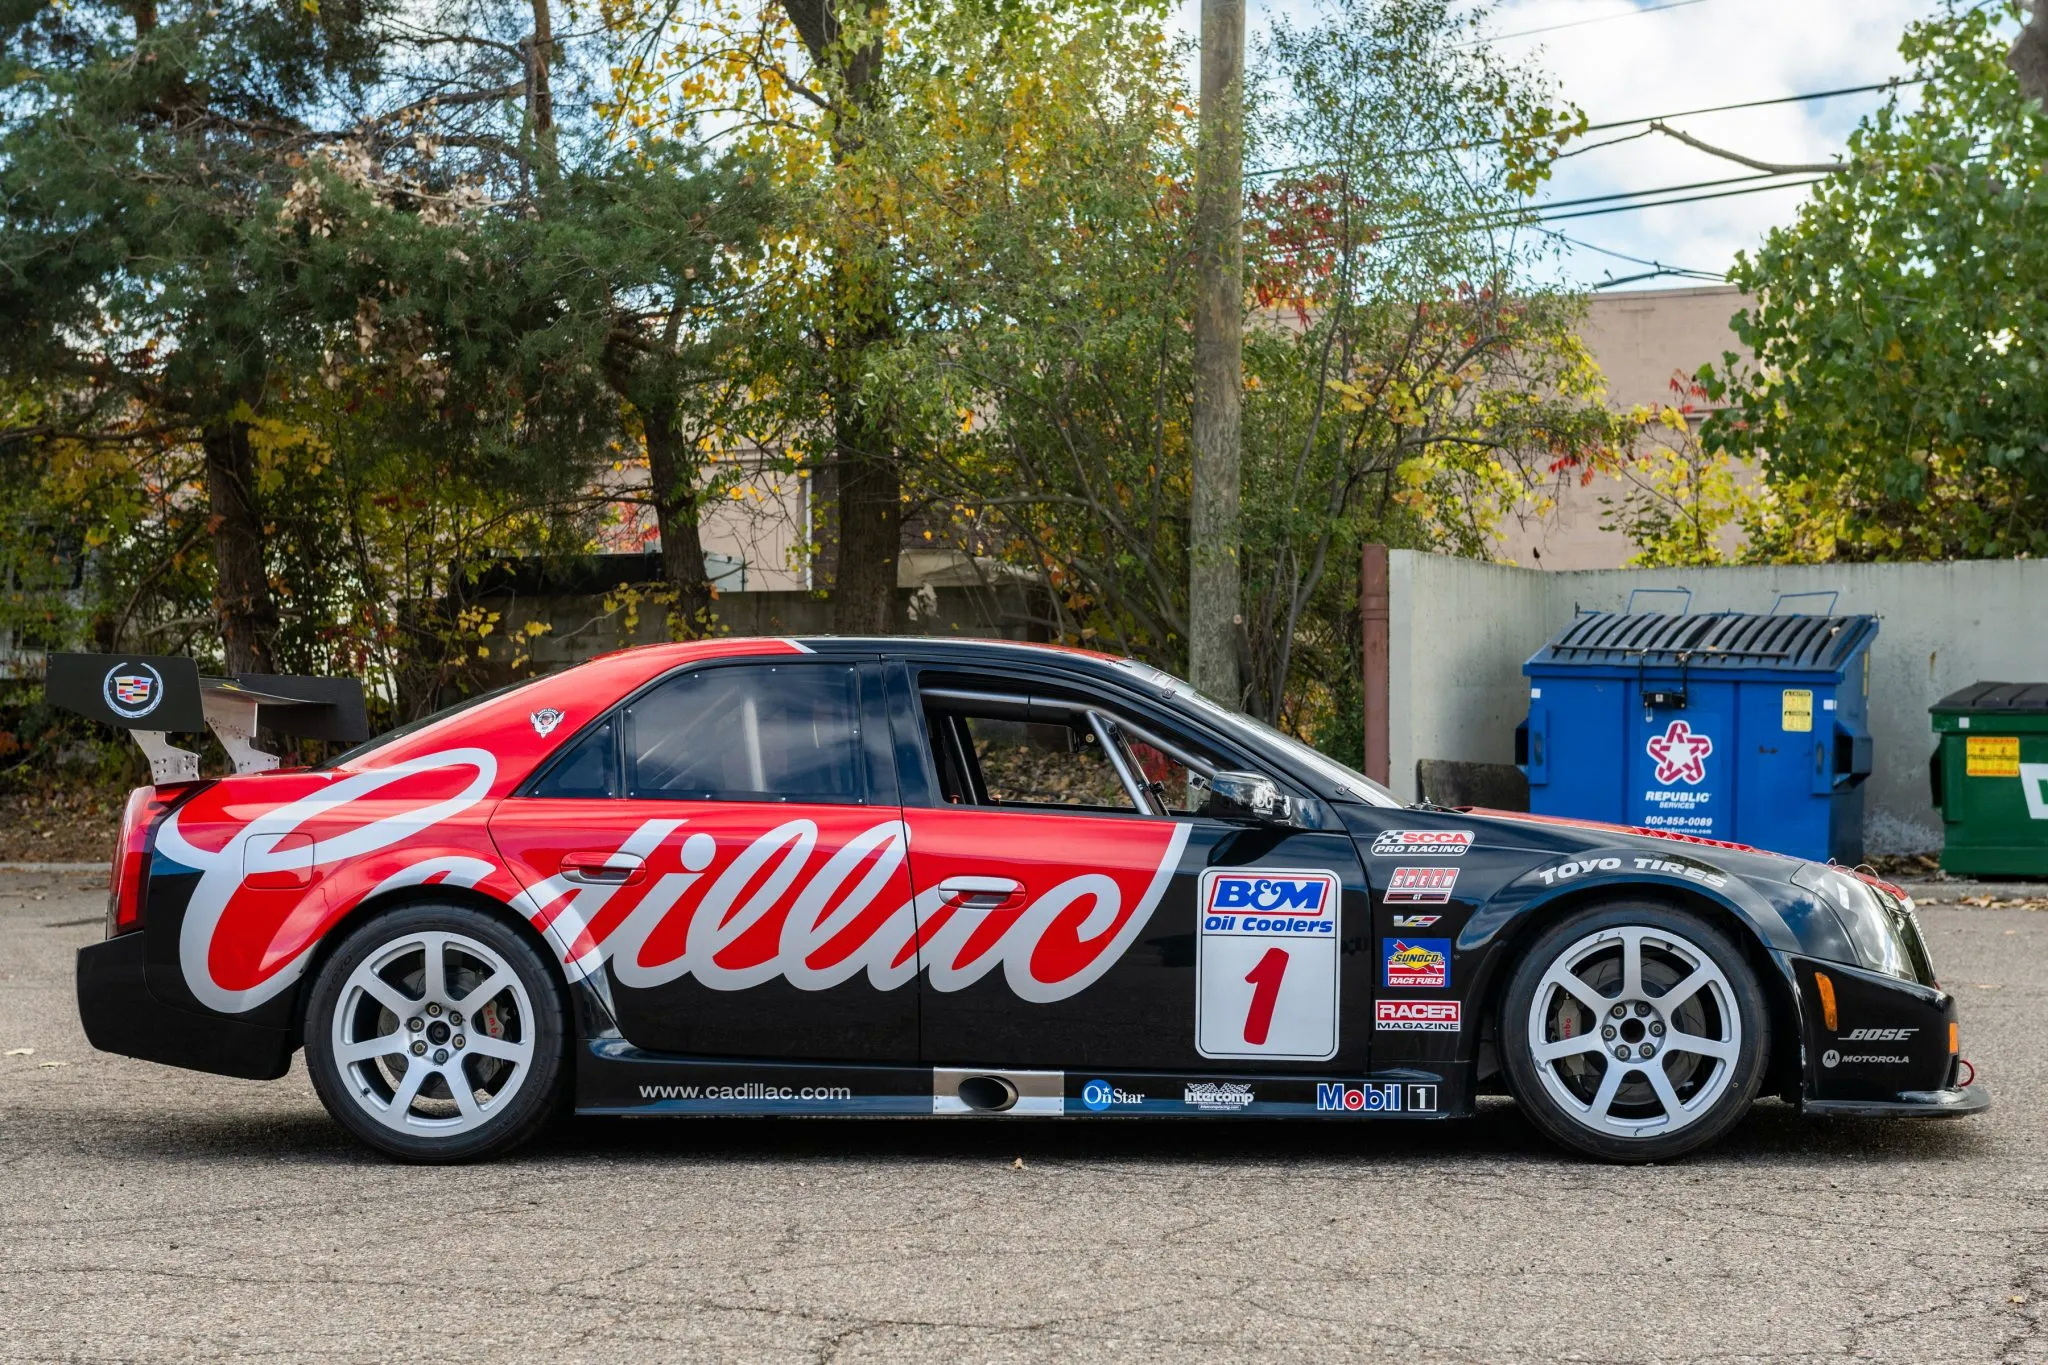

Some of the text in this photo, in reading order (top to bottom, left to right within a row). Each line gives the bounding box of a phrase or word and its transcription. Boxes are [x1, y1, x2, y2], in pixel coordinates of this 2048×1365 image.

[1645, 791, 1709, 803] REPUBLIC
[1645, 816, 1712, 826] 800-858-0089
[1402, 833, 1468, 844] SCCA
[1375, 845, 1466, 853] PRO RACING
[1539, 857, 1728, 888] TOYO TIRES
[1392, 875, 1456, 888] SPEED
[1213, 879, 1325, 911] B&M
[1204, 916, 1334, 933] Oil Coolers
[1394, 953, 1439, 962] SUNOCO
[1389, 977, 1444, 985] RACE FUELS
[1243, 947, 1290, 1046] 1
[1379, 1005, 1457, 1019] RACER
[1377, 1022, 1459, 1030] MAGAZINE
[1838, 1028, 1920, 1041] BOSE
[1842, 1055, 1910, 1064] MOTOROLA
[639, 1083, 851, 1100] www.cadillac.com
[1083, 1085, 1145, 1104] OnStar
[1184, 1088, 1254, 1106] Intercomp
[1317, 1083, 1402, 1111] Mobil
